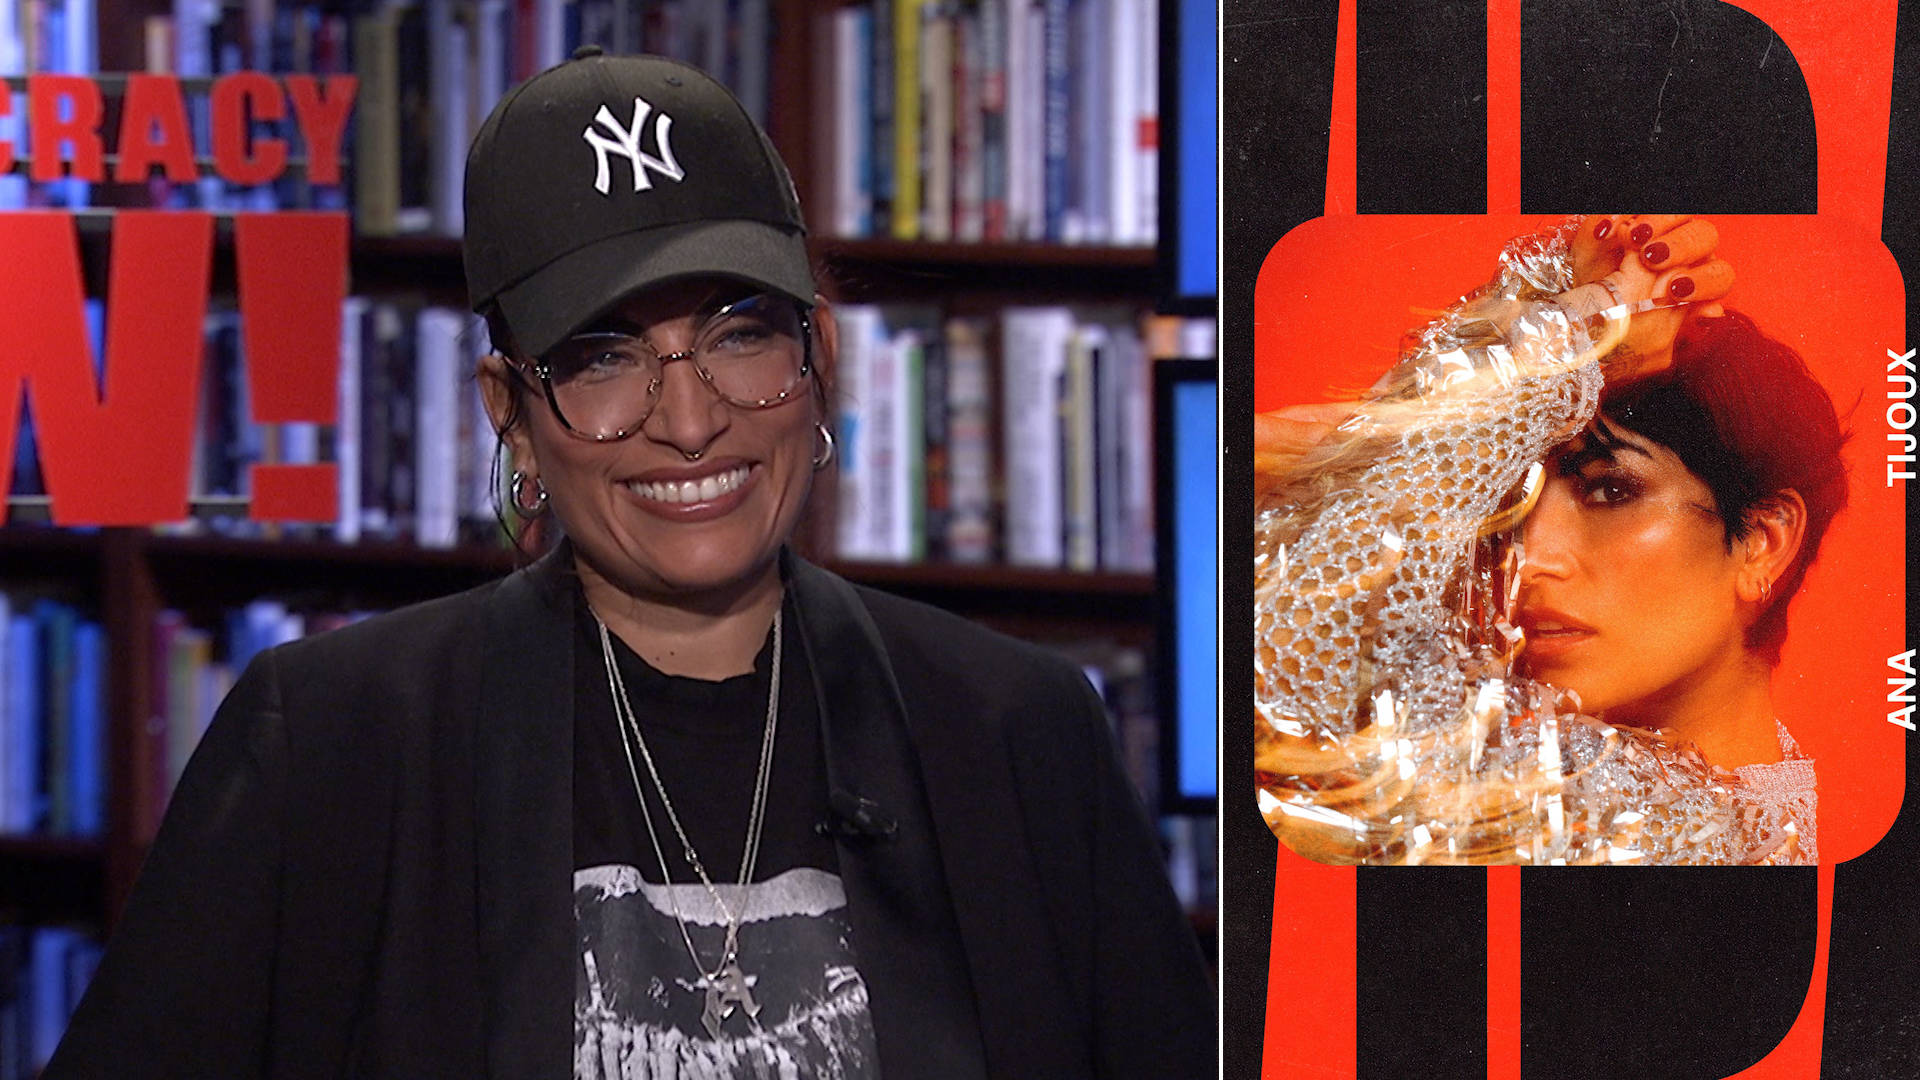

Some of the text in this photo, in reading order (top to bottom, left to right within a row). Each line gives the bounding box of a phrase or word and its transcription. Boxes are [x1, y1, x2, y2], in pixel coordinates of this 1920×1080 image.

[0, 72, 358, 184] RACY
[583, 97, 685, 195] NY
[1887, 348, 1917, 731] ANA TIJOUX
